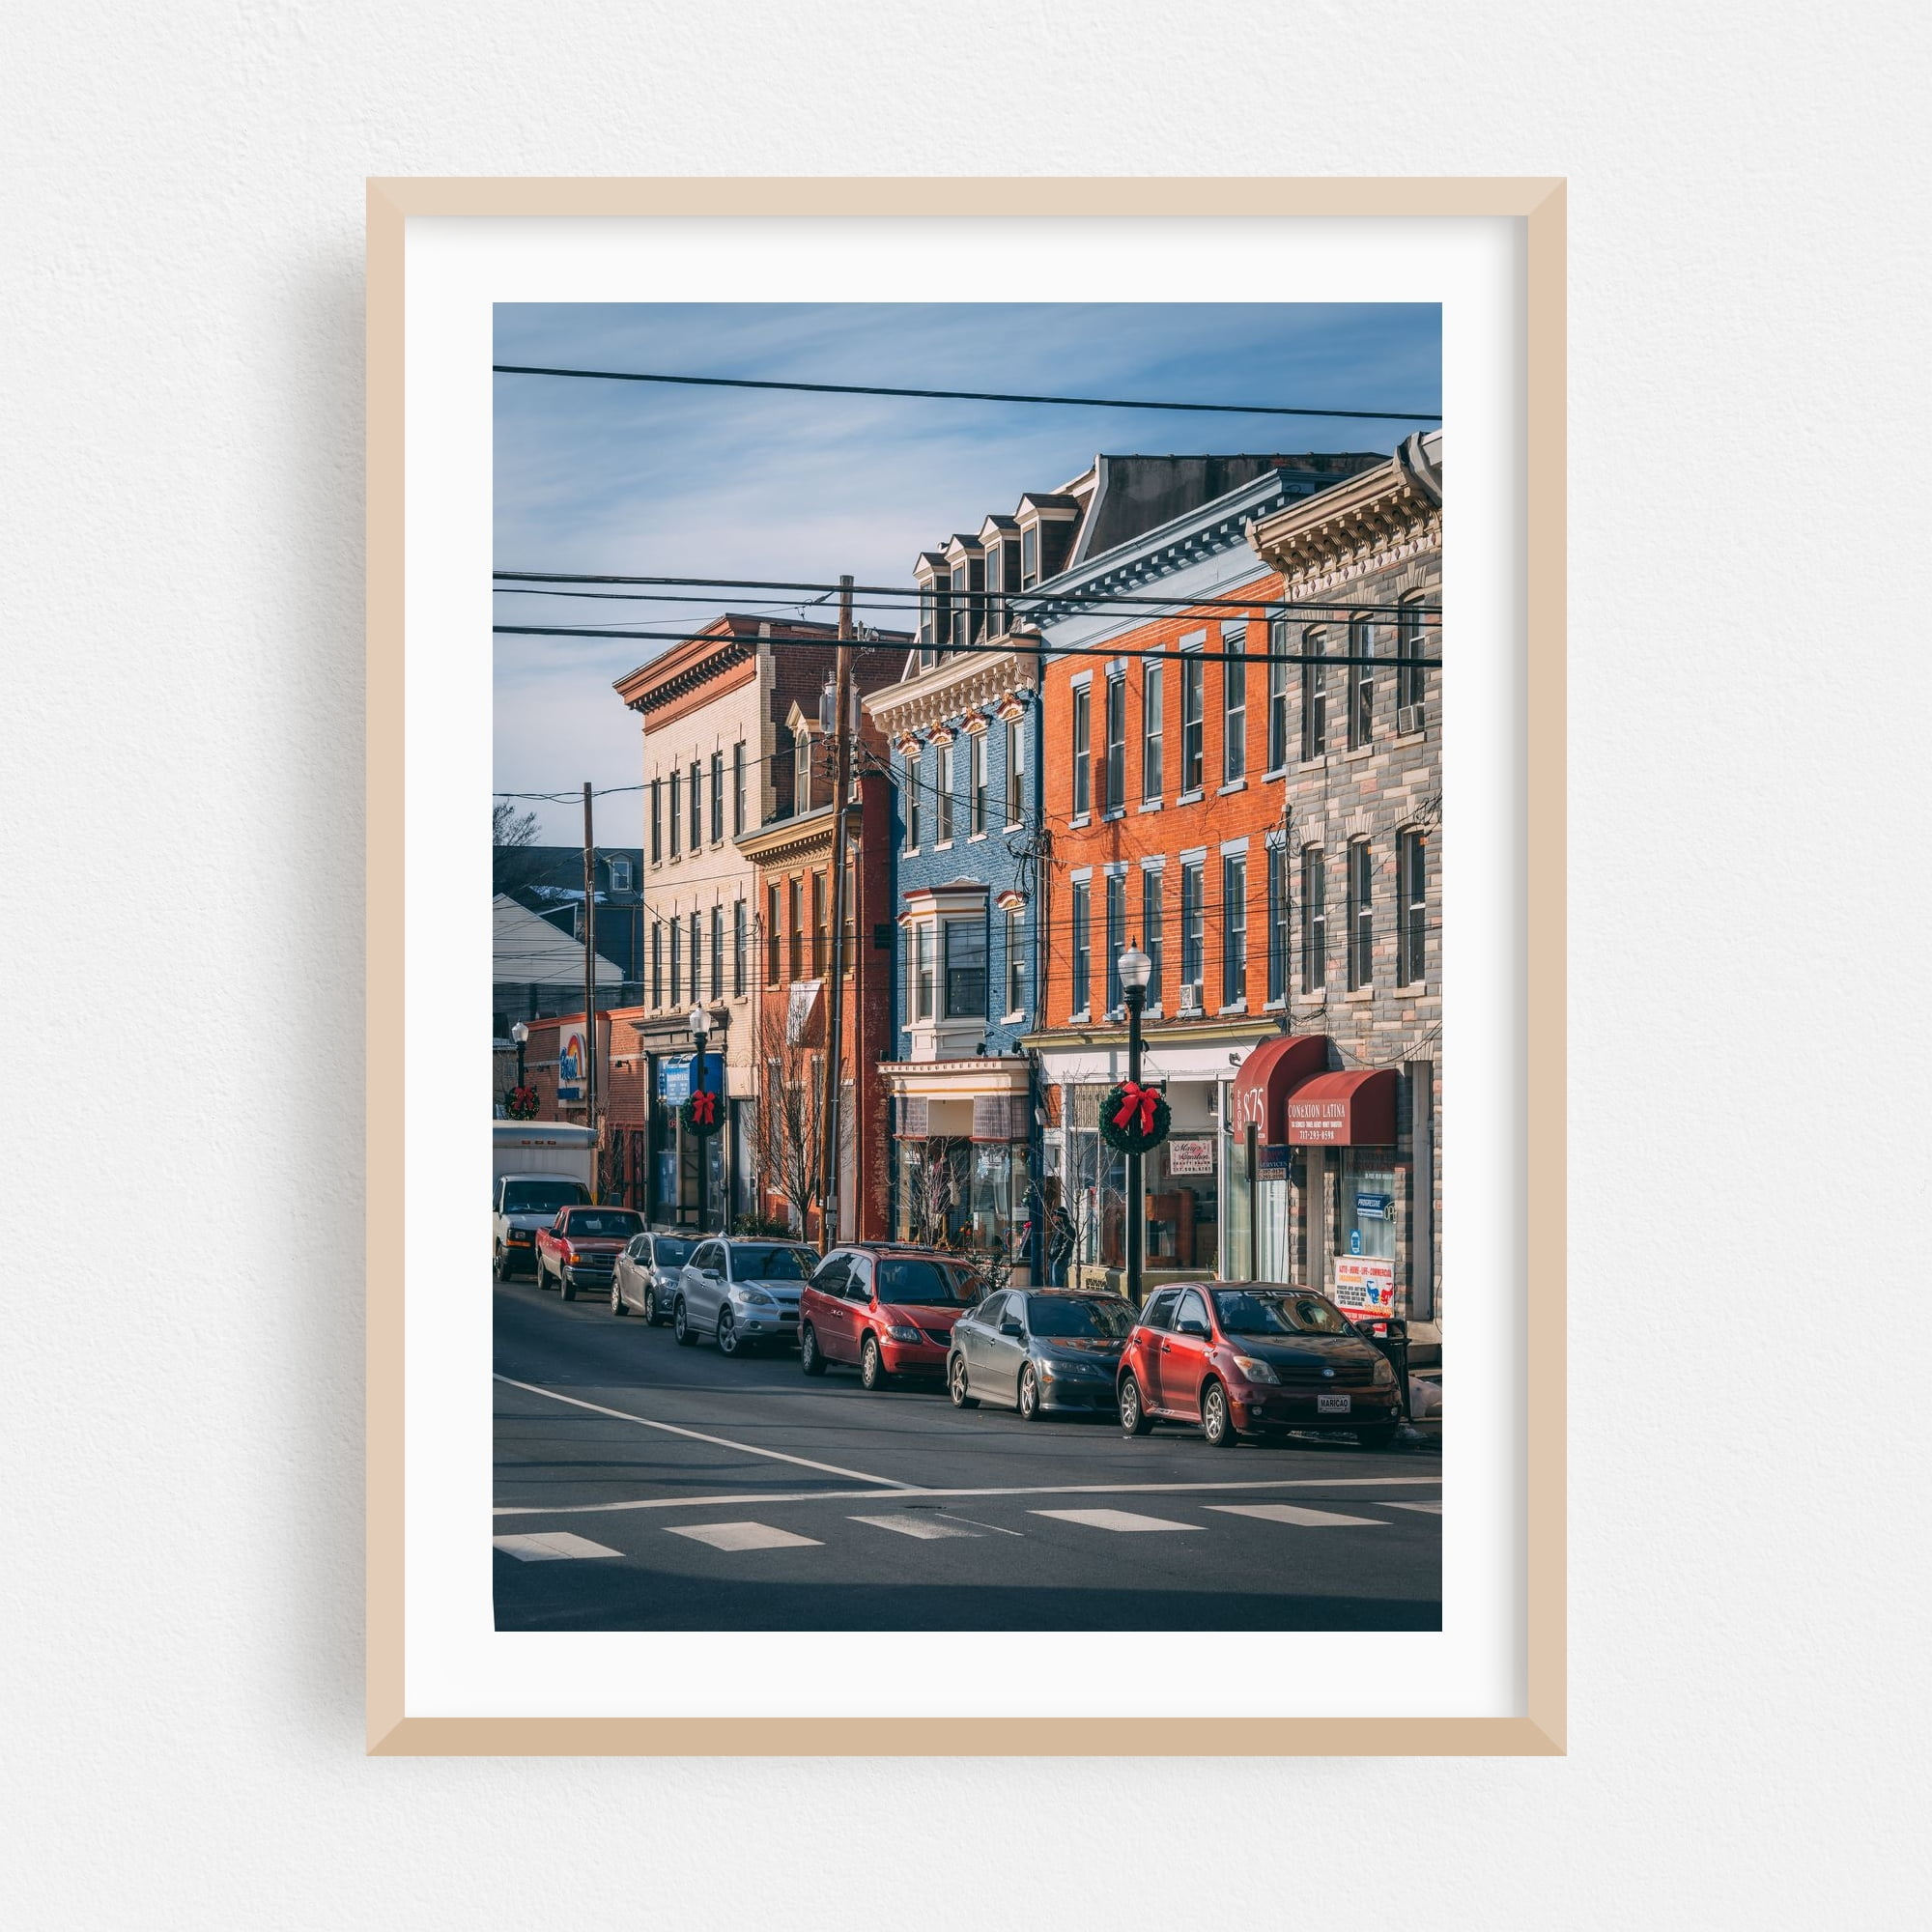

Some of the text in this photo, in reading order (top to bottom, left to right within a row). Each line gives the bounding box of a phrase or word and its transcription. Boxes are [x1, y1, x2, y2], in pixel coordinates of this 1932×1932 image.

[1288, 1103, 1346, 1118] CONEXION LATINA
[1218, 1291, 1318, 1299] SCION
[1320, 1399, 1349, 1407] MARICAO
